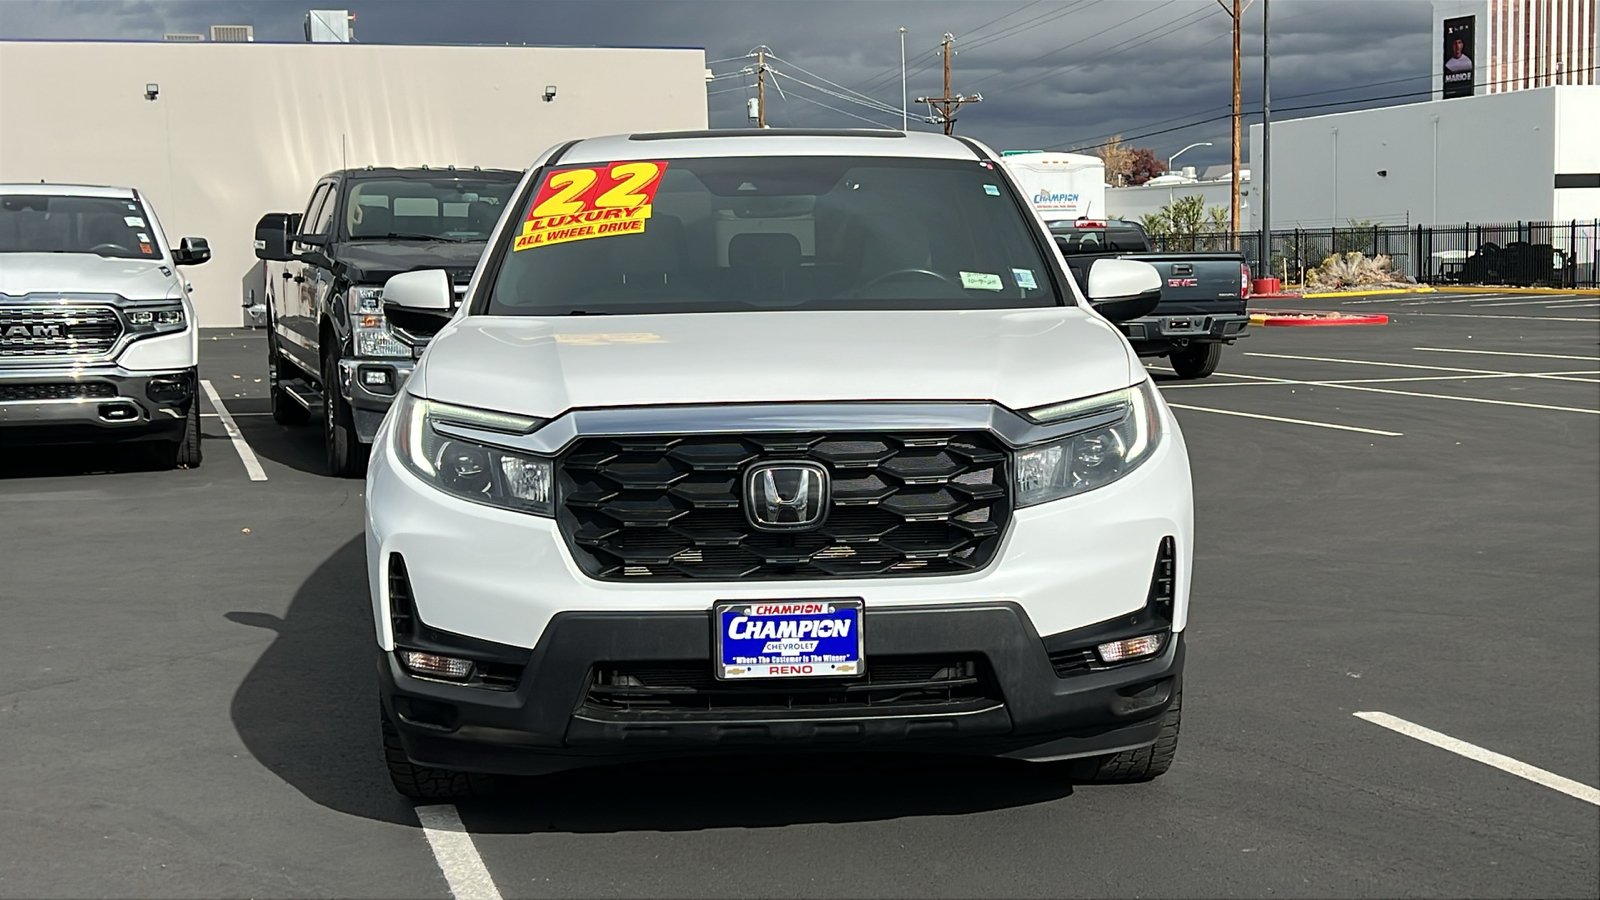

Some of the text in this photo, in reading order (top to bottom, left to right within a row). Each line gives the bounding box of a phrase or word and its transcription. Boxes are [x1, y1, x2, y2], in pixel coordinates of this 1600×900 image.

[532, 162, 660, 217] 22
[1033, 193, 1079, 204] CHAMPION
[531, 206, 643, 232] LUXURY
[516, 220, 643, 247] ALL WHEEL DRIVE
[1168, 278, 1198, 287] GMC
[0, 325, 60, 337] AM
[756, 604, 823, 615] CHAMPION
[728, 616, 851, 640] CHAMPION
[766, 642, 814, 651] CHEVROLET
[758, 656, 770, 664] The
[771, 655, 802, 664] Customer
[810, 655, 822, 663] The
[769, 665, 813, 675] RENO
